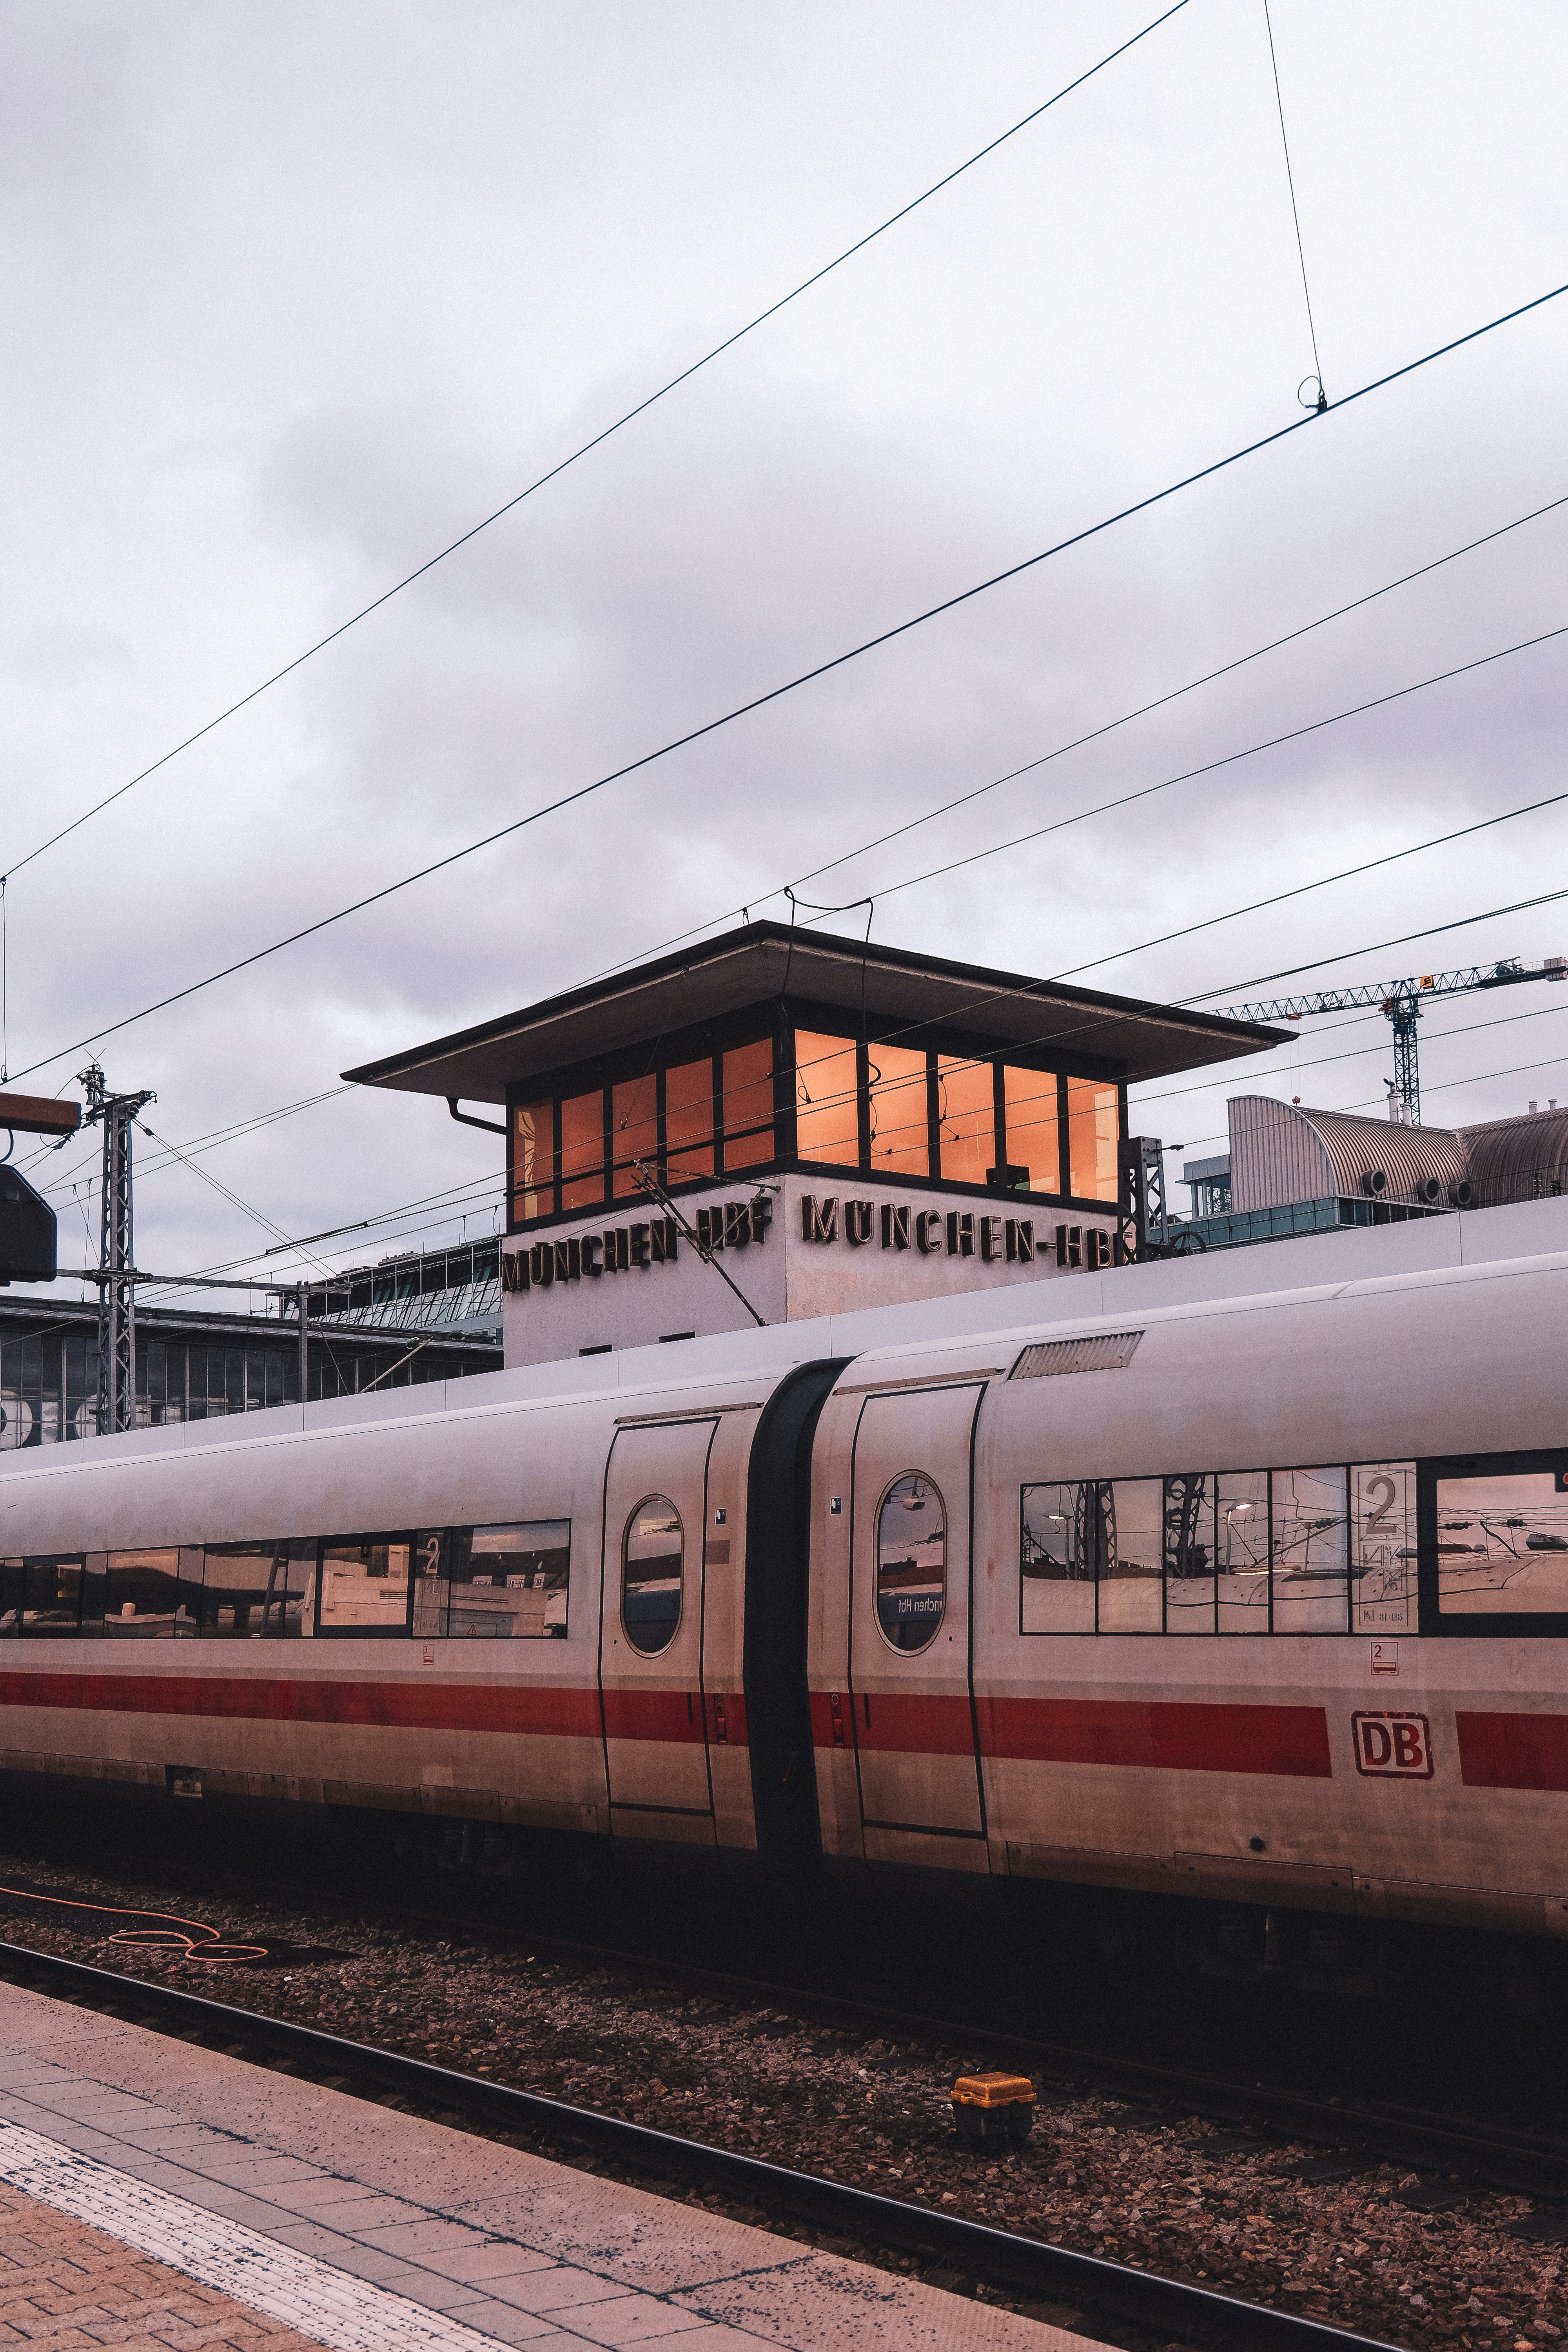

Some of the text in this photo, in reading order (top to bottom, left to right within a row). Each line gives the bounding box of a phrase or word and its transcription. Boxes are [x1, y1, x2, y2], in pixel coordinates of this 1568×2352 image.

[1366, 1476, 1396, 1534] 2
[426, 1537, 439, 1573] 2
[1374, 1644, 1382, 1658] 2
[1361, 1721, 1423, 1768] DB
